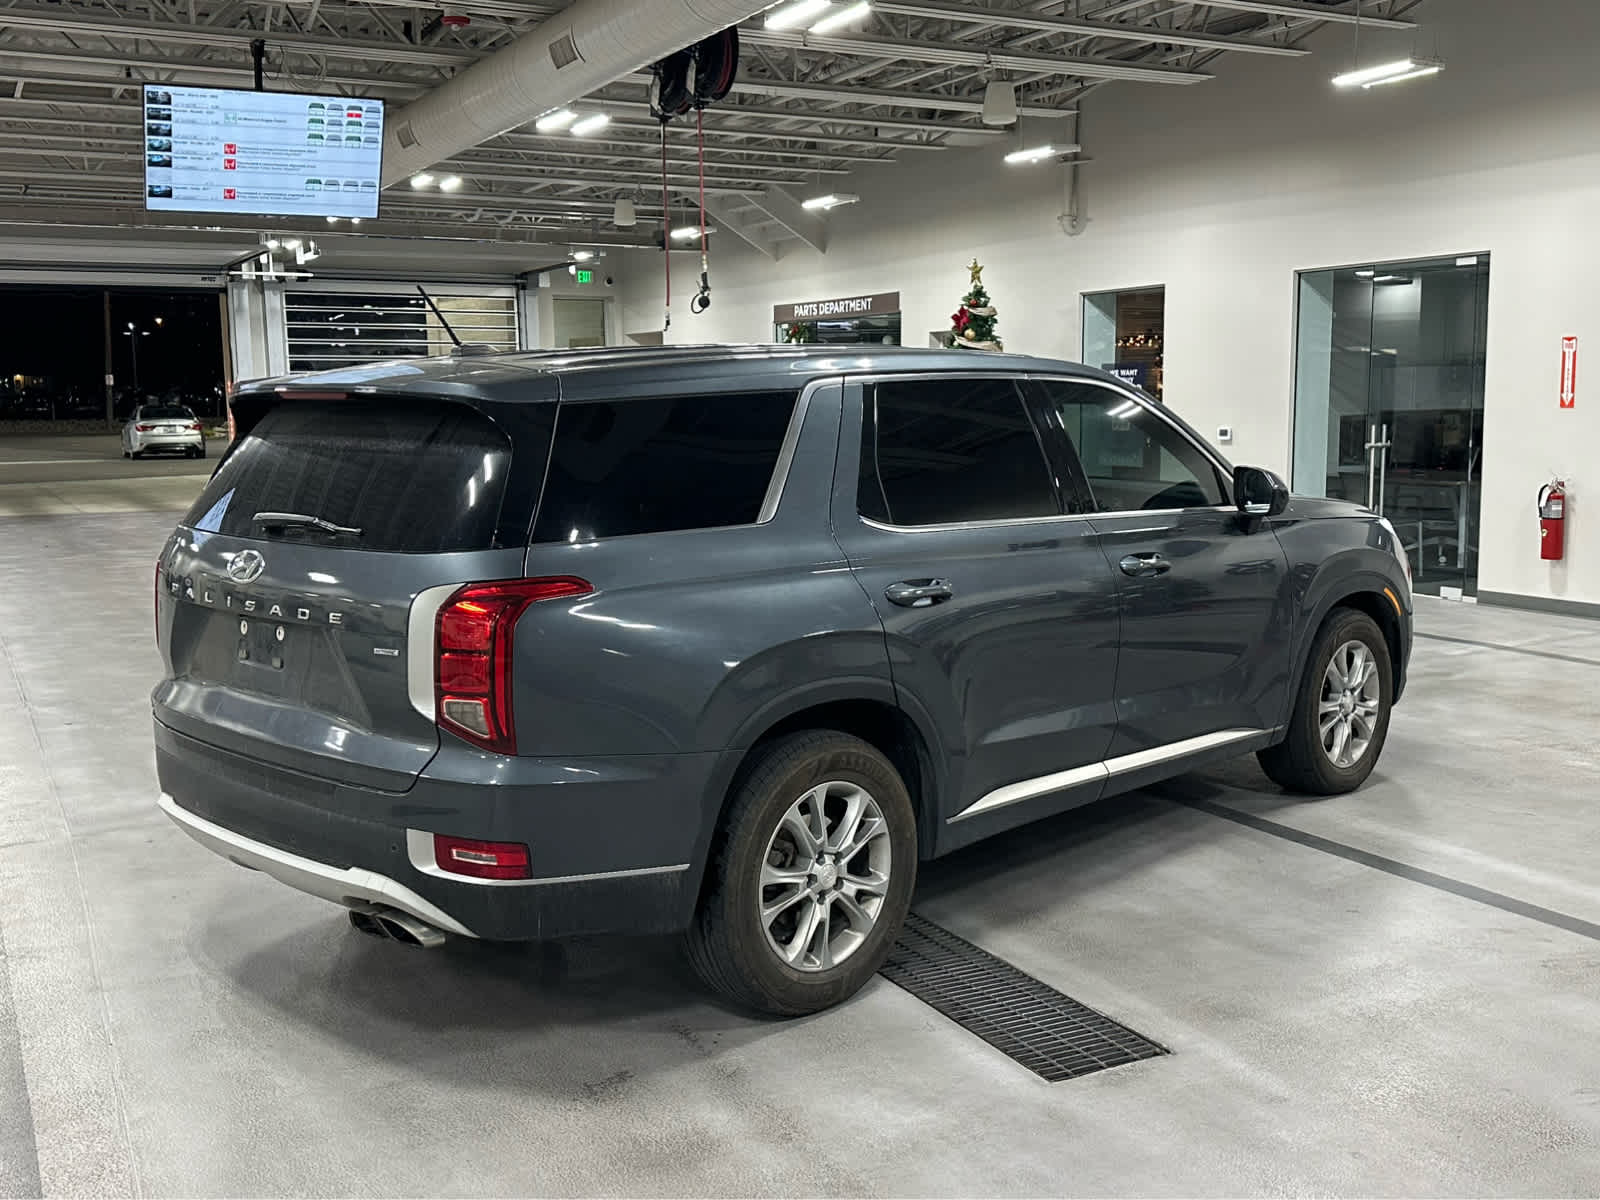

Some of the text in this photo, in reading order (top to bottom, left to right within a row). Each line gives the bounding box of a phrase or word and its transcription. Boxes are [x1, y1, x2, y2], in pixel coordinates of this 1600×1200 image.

[794, 298, 873, 317] PARTS DEPARTMENT
[1120, 369, 1138, 377] WANT
[171, 583, 343, 625] PALISADE
